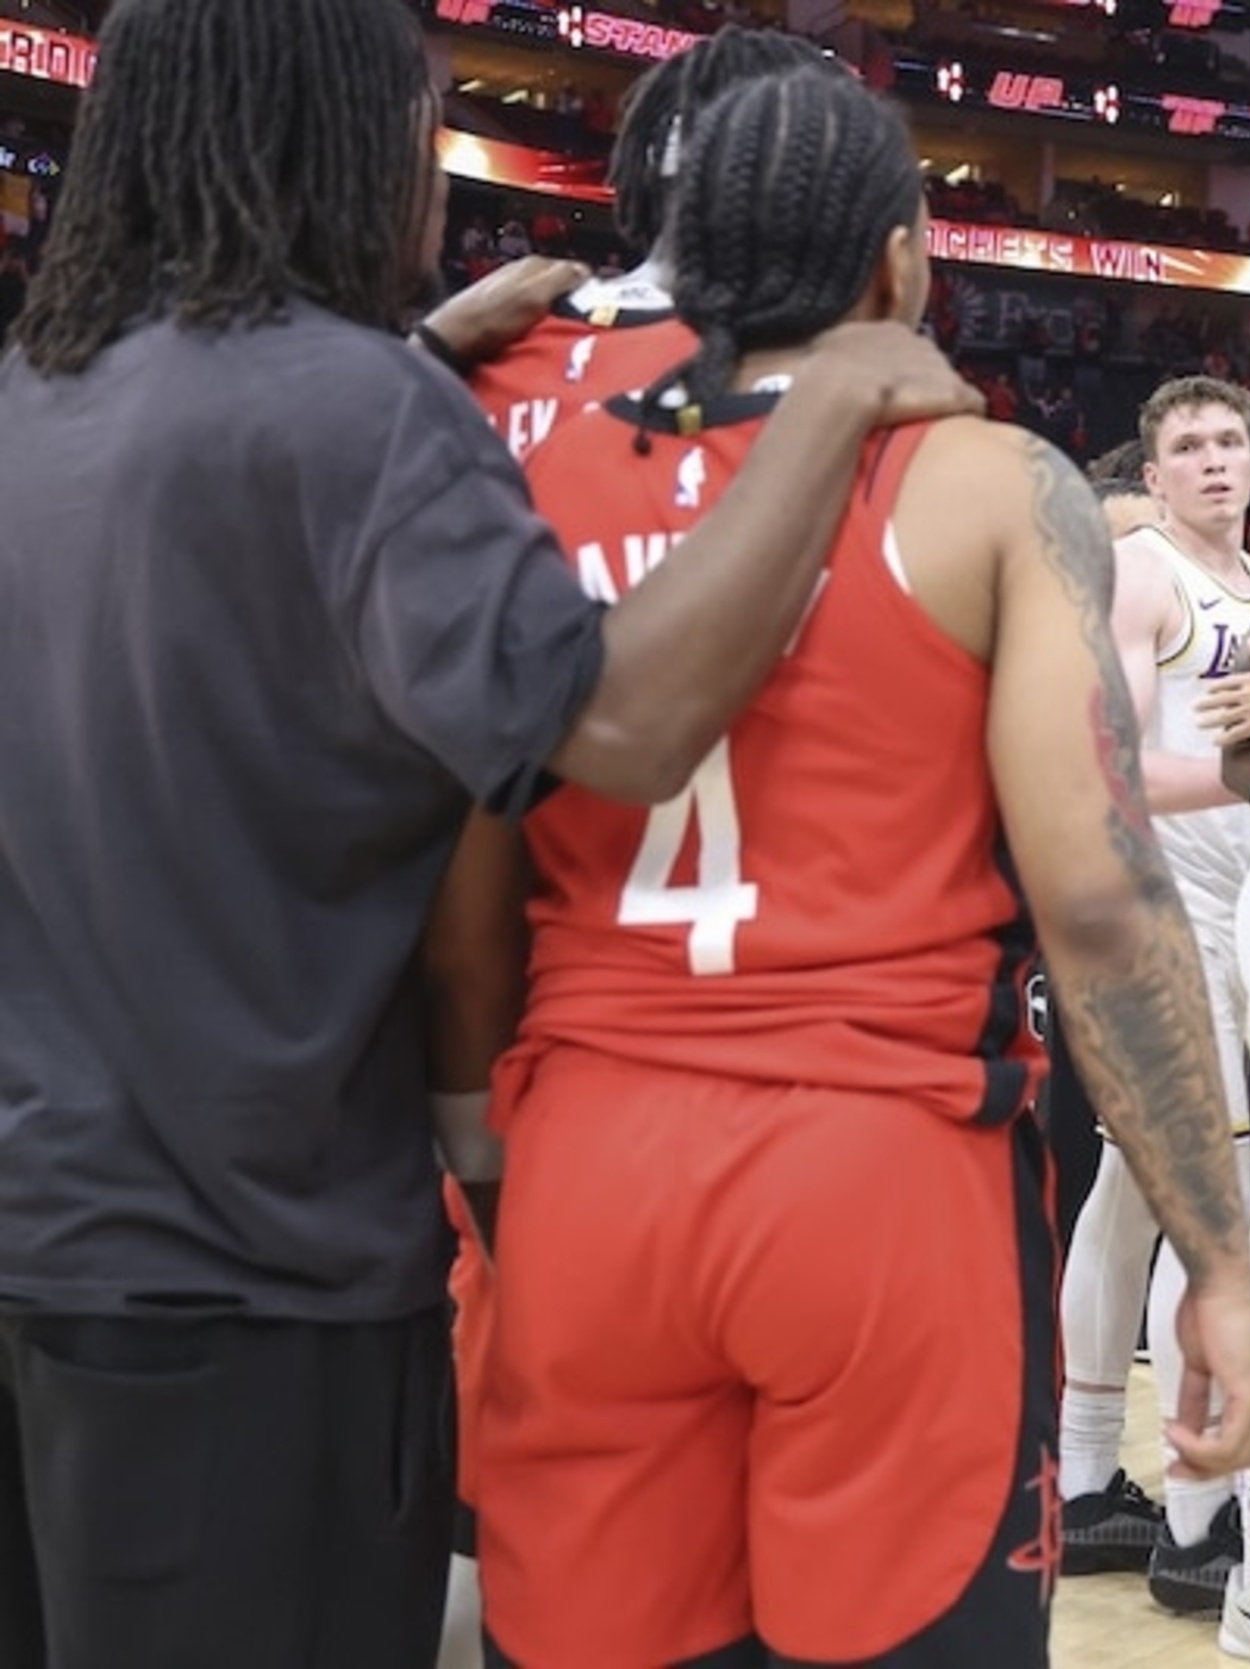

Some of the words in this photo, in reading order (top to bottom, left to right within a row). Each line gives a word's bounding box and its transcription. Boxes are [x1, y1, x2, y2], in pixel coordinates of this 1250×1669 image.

[989, 71, 1063, 109] UP
[1090, 241, 1166, 283] WIN
[616, 733, 758, 977] 4
